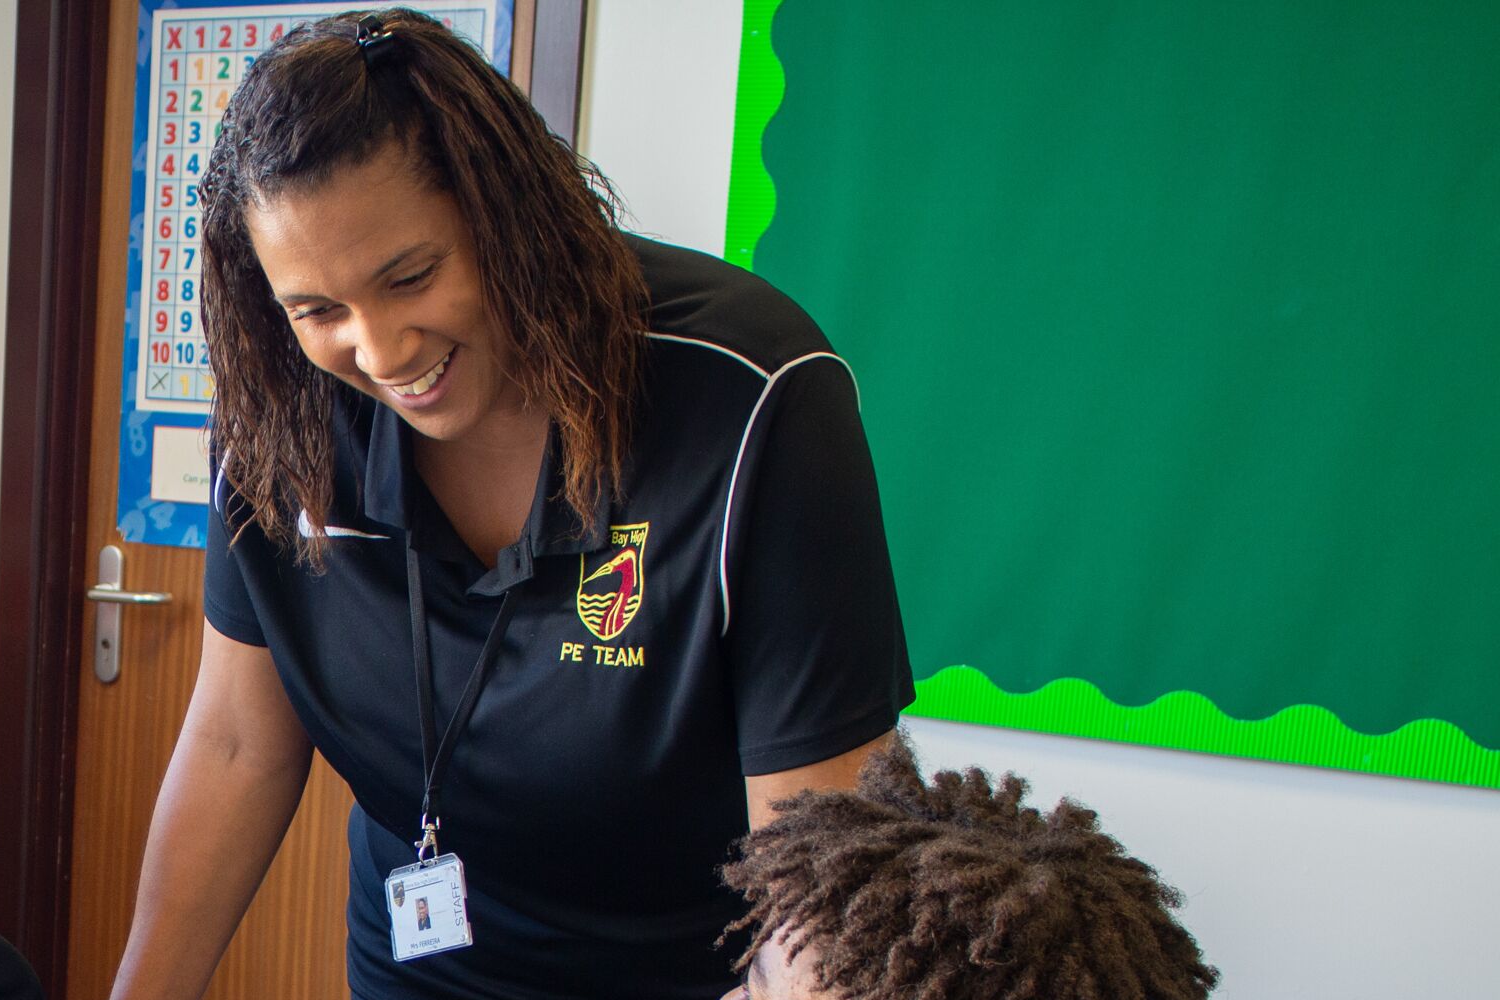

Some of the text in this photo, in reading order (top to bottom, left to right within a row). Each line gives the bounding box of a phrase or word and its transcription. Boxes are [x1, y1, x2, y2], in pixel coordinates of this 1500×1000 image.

[167, 23, 284, 49] X 1 2 3 4
[169, 58, 179, 81] 1
[194, 57, 204, 80] 1
[218, 57, 230, 79] 2
[165, 90, 178, 113] 2
[190, 90, 203, 112] 2
[164, 121, 201, 145] 3 3
[162, 153, 200, 176] 4 4
[161, 184, 198, 207] 5 5
[159, 217, 196, 239] 6 6
[159, 248, 195, 270] 7 7
[157, 279, 194, 302] 8 8
[156, 311, 192, 333] 9 9
[151, 342, 170, 364] 10
[176, 342, 194, 364] 10
[179, 374, 189, 396] 1
[612, 531, 629, 547] Bay
[560, 642, 645, 667] PE TEAM
[451, 881, 464, 926] STAFF
